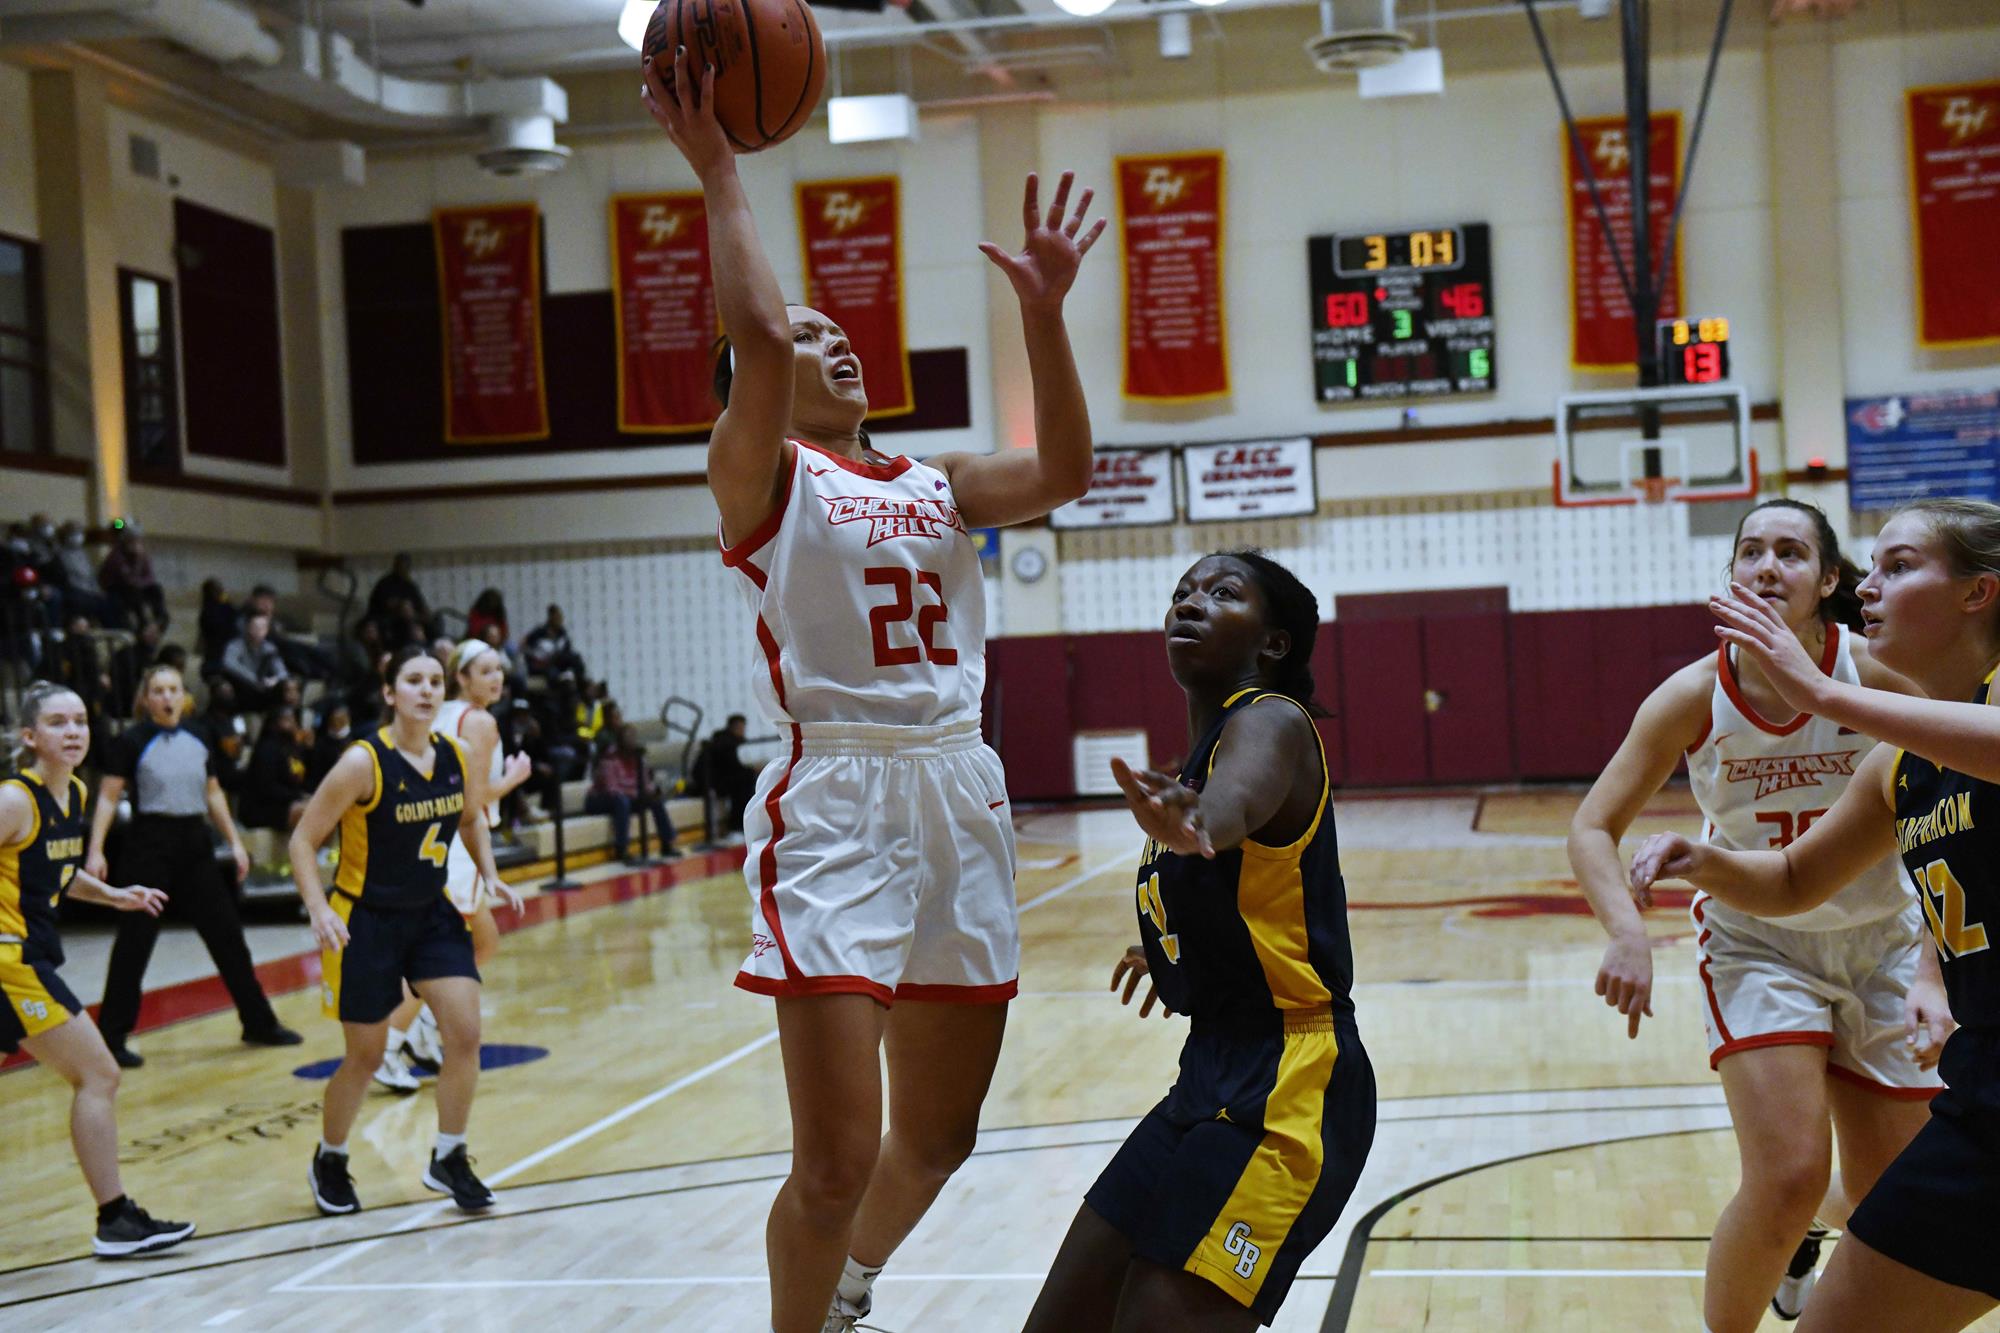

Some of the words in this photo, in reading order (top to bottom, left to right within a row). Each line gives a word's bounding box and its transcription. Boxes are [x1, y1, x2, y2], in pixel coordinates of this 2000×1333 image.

[1326, 292, 1369, 328] 60
[1441, 282, 1484, 319] 46
[1392, 309, 1412, 338] 3
[1346, 358, 1357, 387] 1
[1684, 343, 1721, 384] 13
[1093, 453, 1146, 473] ACC
[864, 566, 958, 667] 22
[1725, 752, 1858, 783] CHESTNUT
[396, 792, 464, 823] GOLDEY-BEACO
[419, 822, 448, 868] 4
[1913, 858, 1991, 963] 12
[1223, 1221, 1261, 1279] GB
